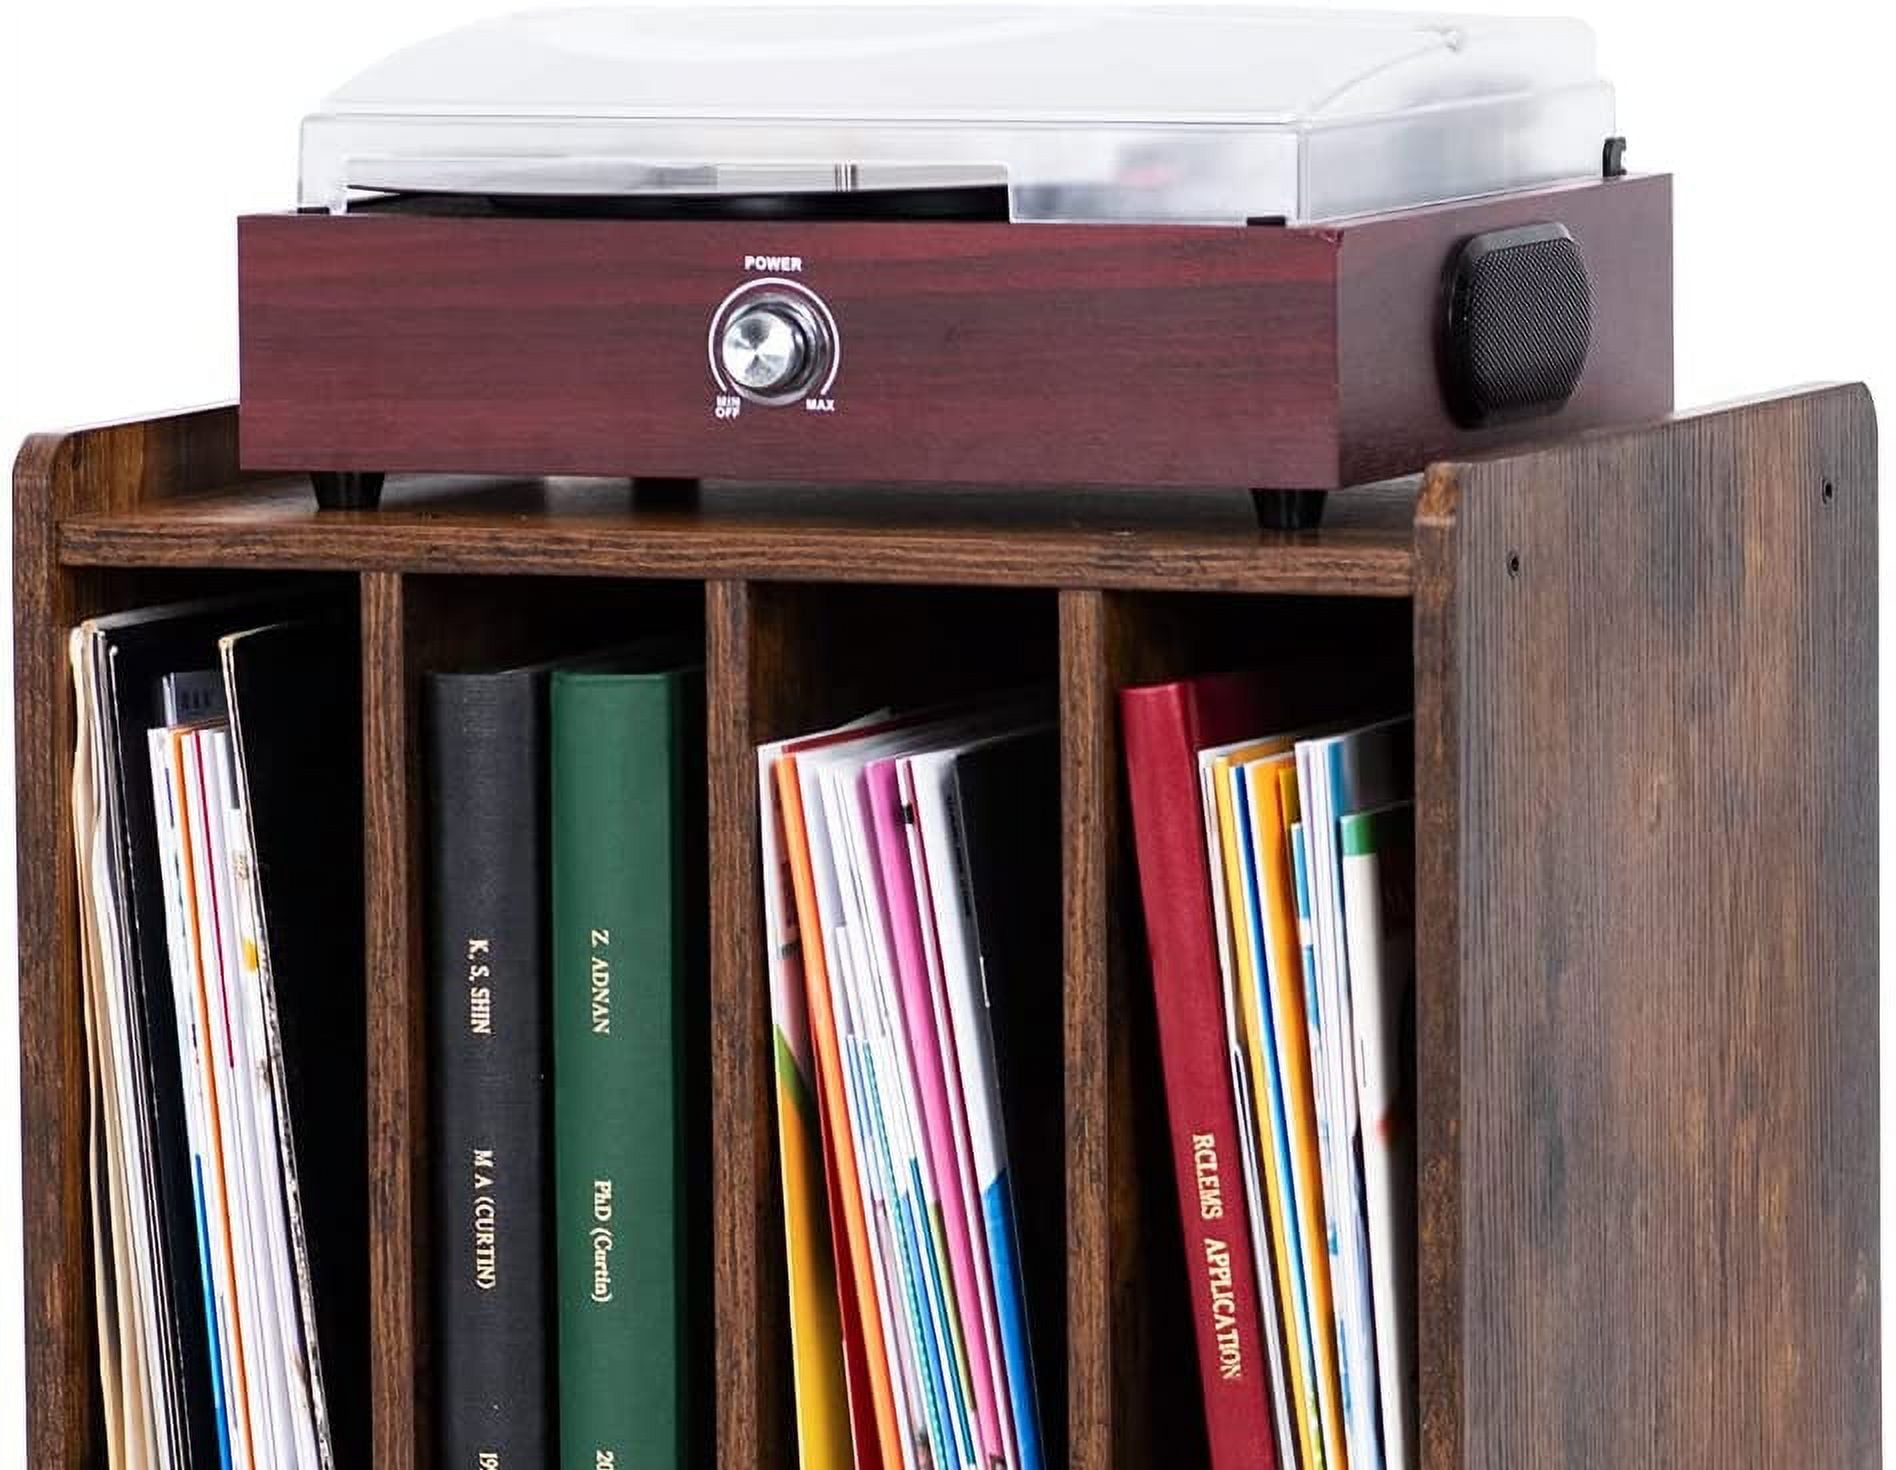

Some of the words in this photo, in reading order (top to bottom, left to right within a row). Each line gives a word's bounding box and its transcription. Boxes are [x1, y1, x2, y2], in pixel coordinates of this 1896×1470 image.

[744, 255, 802, 272] POWER
[715, 407, 741, 419] OFF
[716, 396, 741, 407] MIN
[805, 398, 835, 412] MAX
[467, 938, 490, 960] K.
[468, 964, 490, 982] S.
[470, 987, 492, 1035] SHIN
[591, 956, 611, 1035] ADNAN
[1192, 1133, 1224, 1220] RCLEMS
[593, 1179, 612, 1222] PhD
[474, 1196, 496, 1290] (CURTIN)
[589, 1227, 614, 1303] (Curtin)
[1203, 1237, 1242, 1382] APPLICATION
